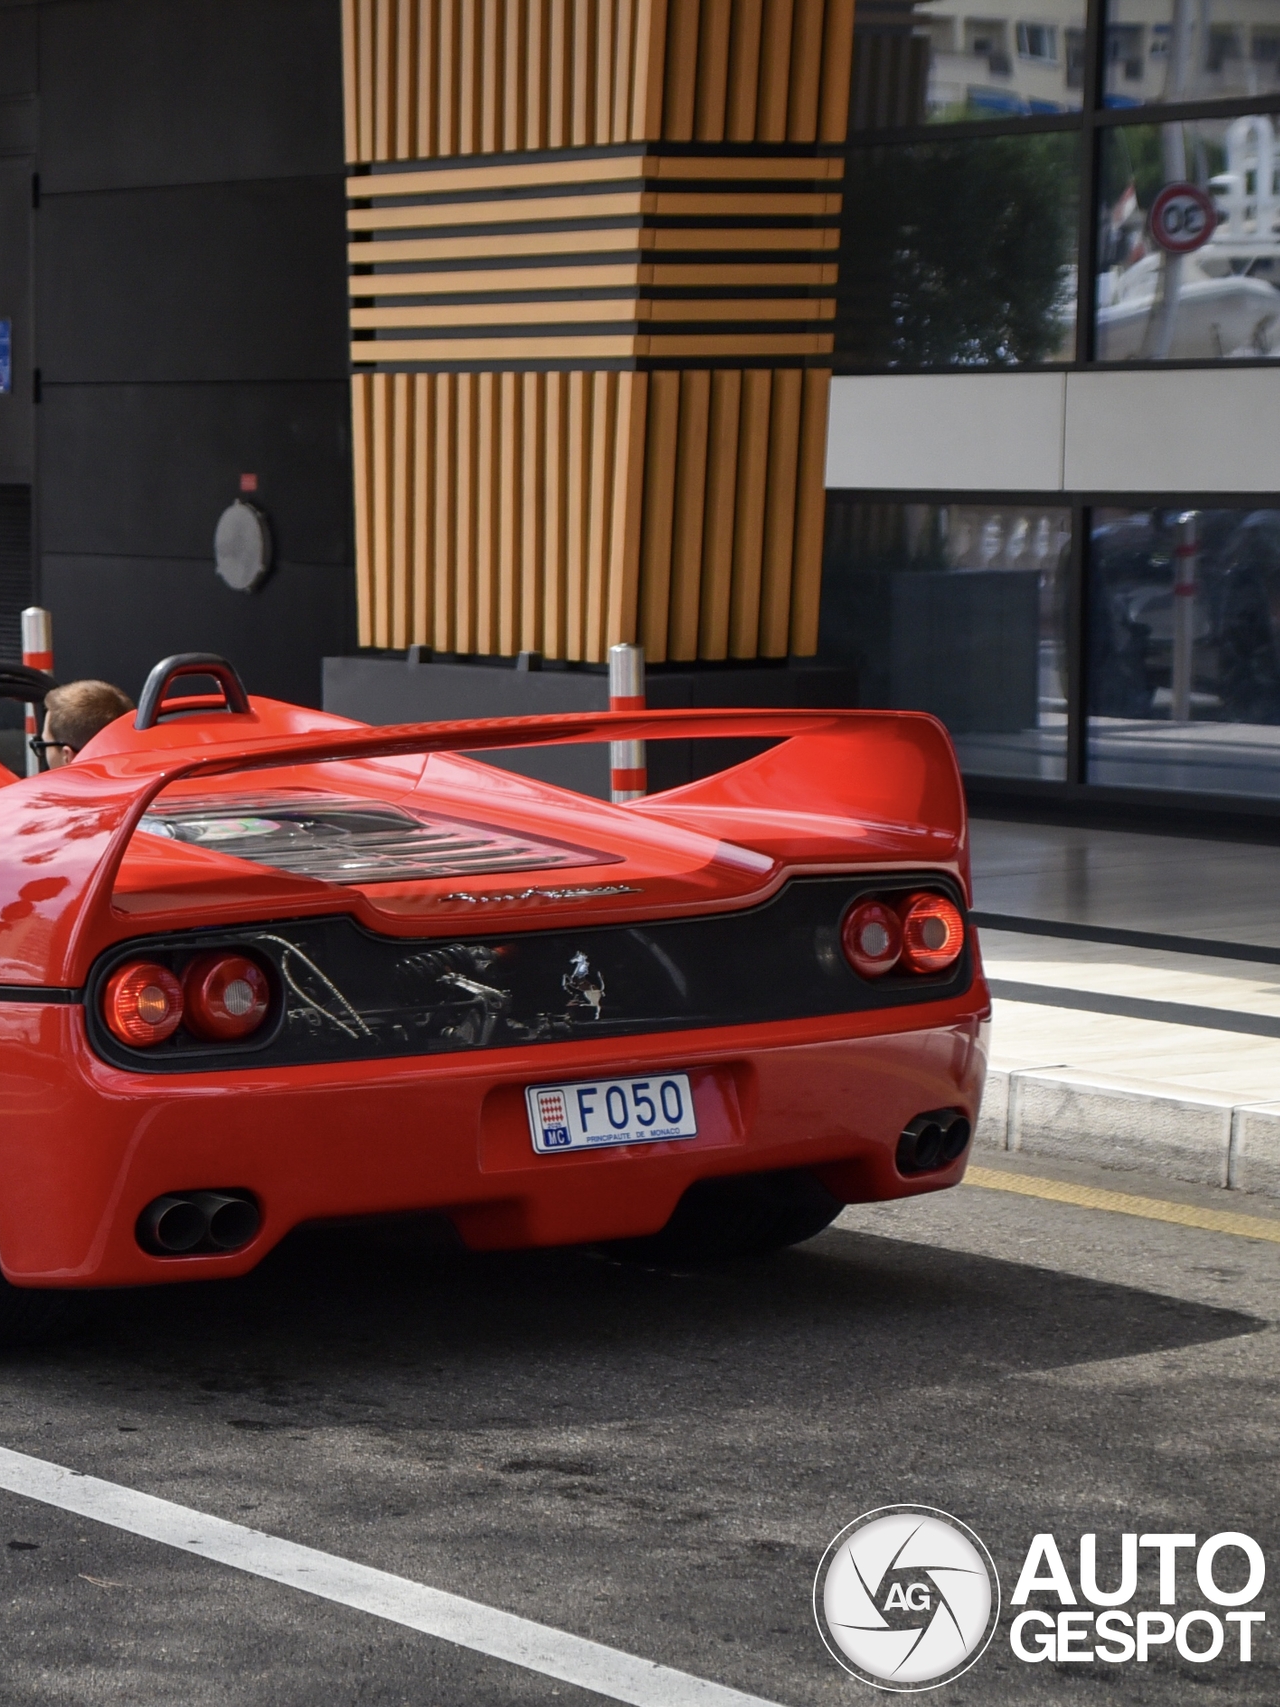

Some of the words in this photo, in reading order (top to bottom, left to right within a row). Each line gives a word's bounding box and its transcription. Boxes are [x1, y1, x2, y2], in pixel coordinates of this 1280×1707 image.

[548, 1133, 565, 1145] MC
[586, 1132, 631, 1143] PRINCIPAUTE
[650, 1128, 681, 1137] MONACO
